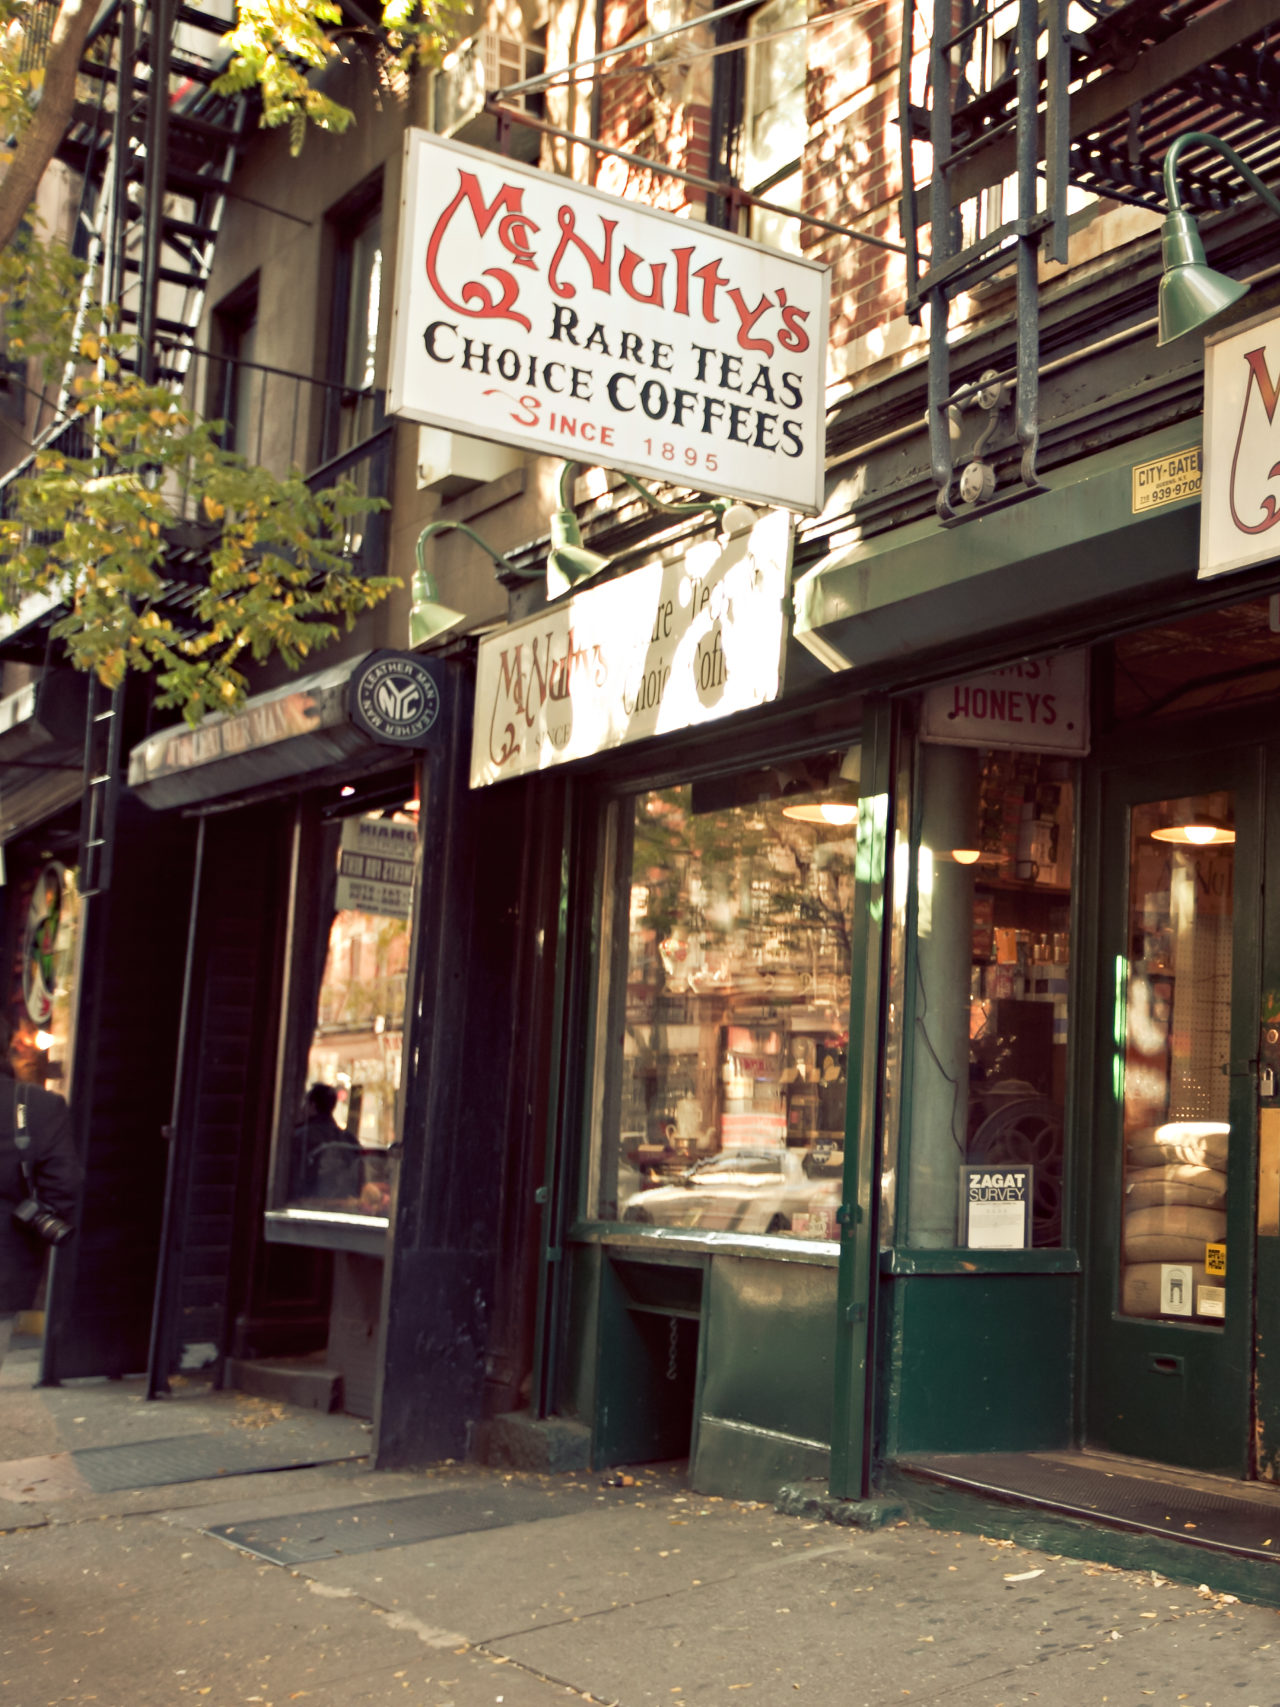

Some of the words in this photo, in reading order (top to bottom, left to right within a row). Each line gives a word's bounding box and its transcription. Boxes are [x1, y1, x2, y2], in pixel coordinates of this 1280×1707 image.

[549, 302, 674, 373] RARE
[691, 343, 803, 410] TEAS
[423, 321, 593, 402] CHOICE
[607, 372, 804, 458] COFFEES
[482, 389, 616, 447] SINCE
[643, 438, 719, 472] 1895
[364, 663, 414, 690] LEATHER
[416, 672, 436, 699] MAN
[379, 678, 420, 720] NYC
[954, 685, 1057, 725] HONEYS
[969, 1173, 1026, 1188] ZAGAT
[969, 1188, 1025, 1201] SURVEY
